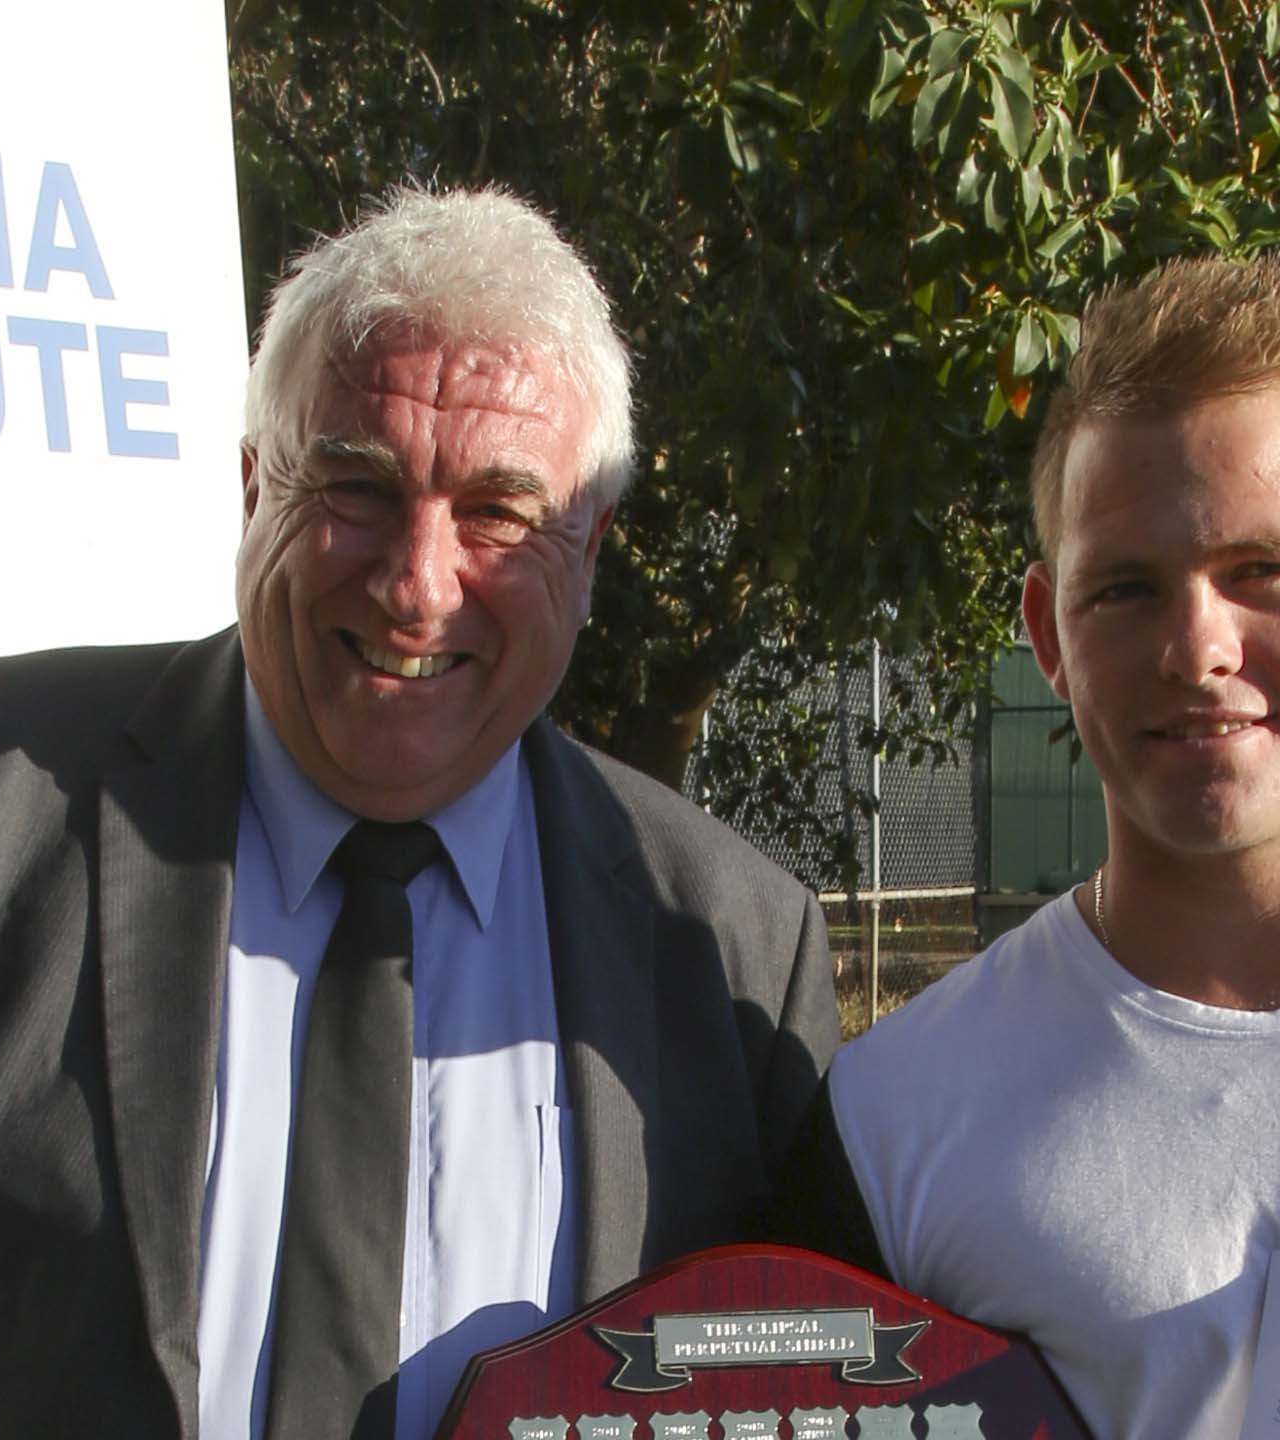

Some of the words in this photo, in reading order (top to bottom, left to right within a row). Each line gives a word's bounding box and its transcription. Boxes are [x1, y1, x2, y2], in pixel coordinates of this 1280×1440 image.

[703, 1323, 742, 1337] THE
[747, 1319, 823, 1336] CLIPSAL
[674, 1339, 782, 1356] PERPETUAL
[785, 1337, 855, 1352] SHIELD
